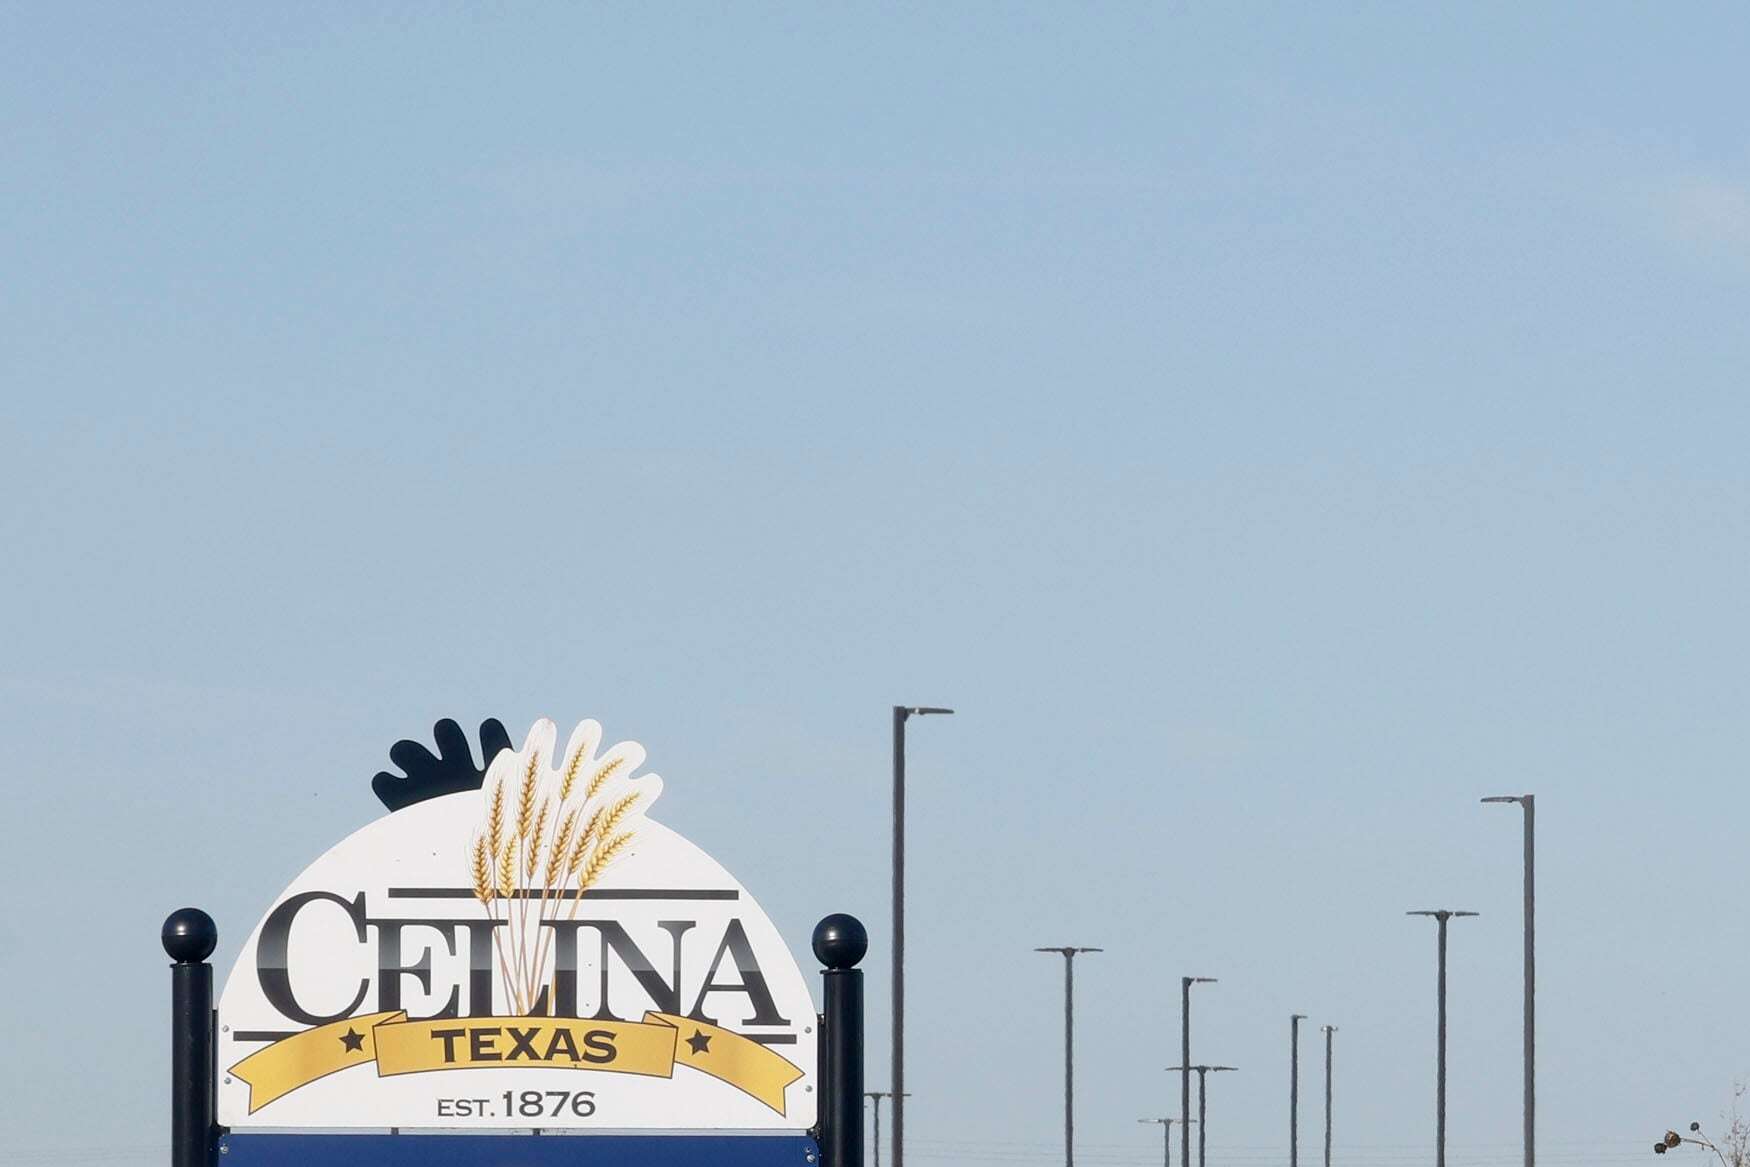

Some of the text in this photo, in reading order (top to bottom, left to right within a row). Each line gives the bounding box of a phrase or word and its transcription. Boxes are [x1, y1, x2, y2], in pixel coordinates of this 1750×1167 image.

[256, 891, 791, 1026] CELINA
[431, 1027, 618, 1064] TEXAS
[437, 1091, 596, 1118] EST. 1876
